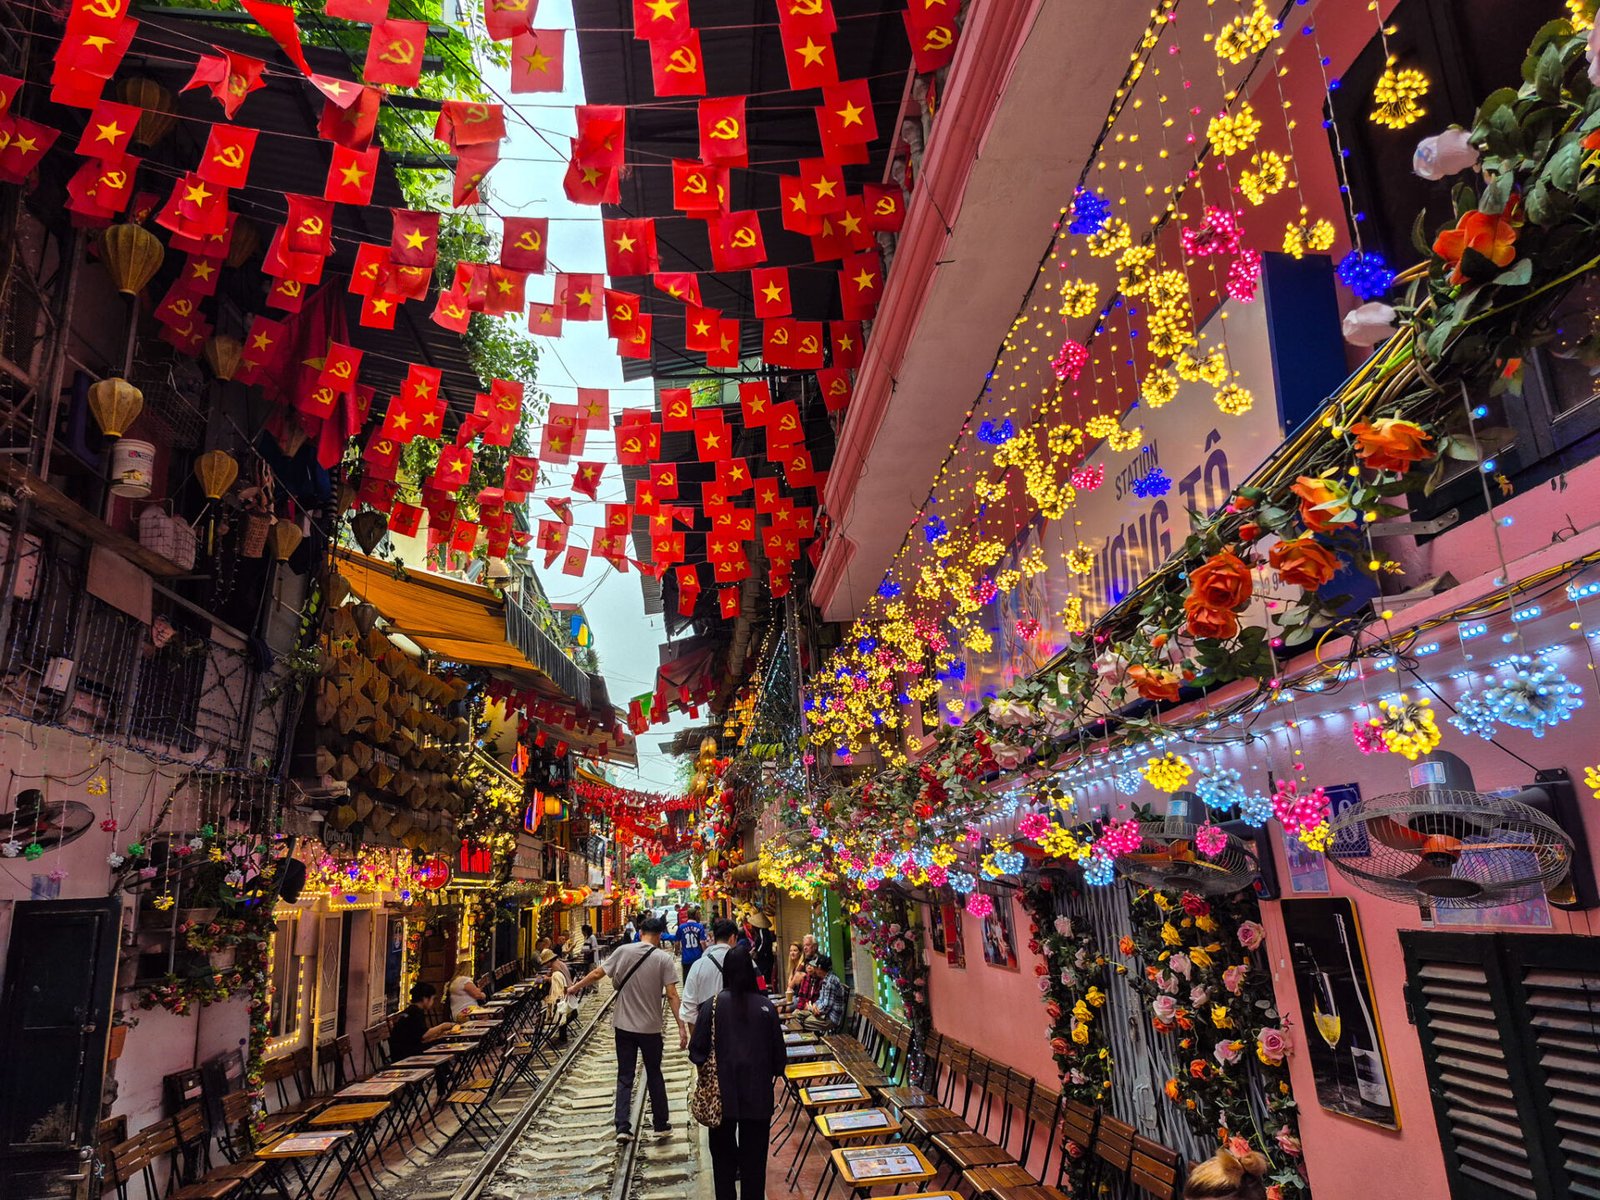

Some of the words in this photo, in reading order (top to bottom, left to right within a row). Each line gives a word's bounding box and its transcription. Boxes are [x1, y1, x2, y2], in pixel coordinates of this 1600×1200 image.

[1115, 439, 1158, 501] STATION
[1179, 428, 1231, 533] TÔ
[685, 933, 698, 948] 10
